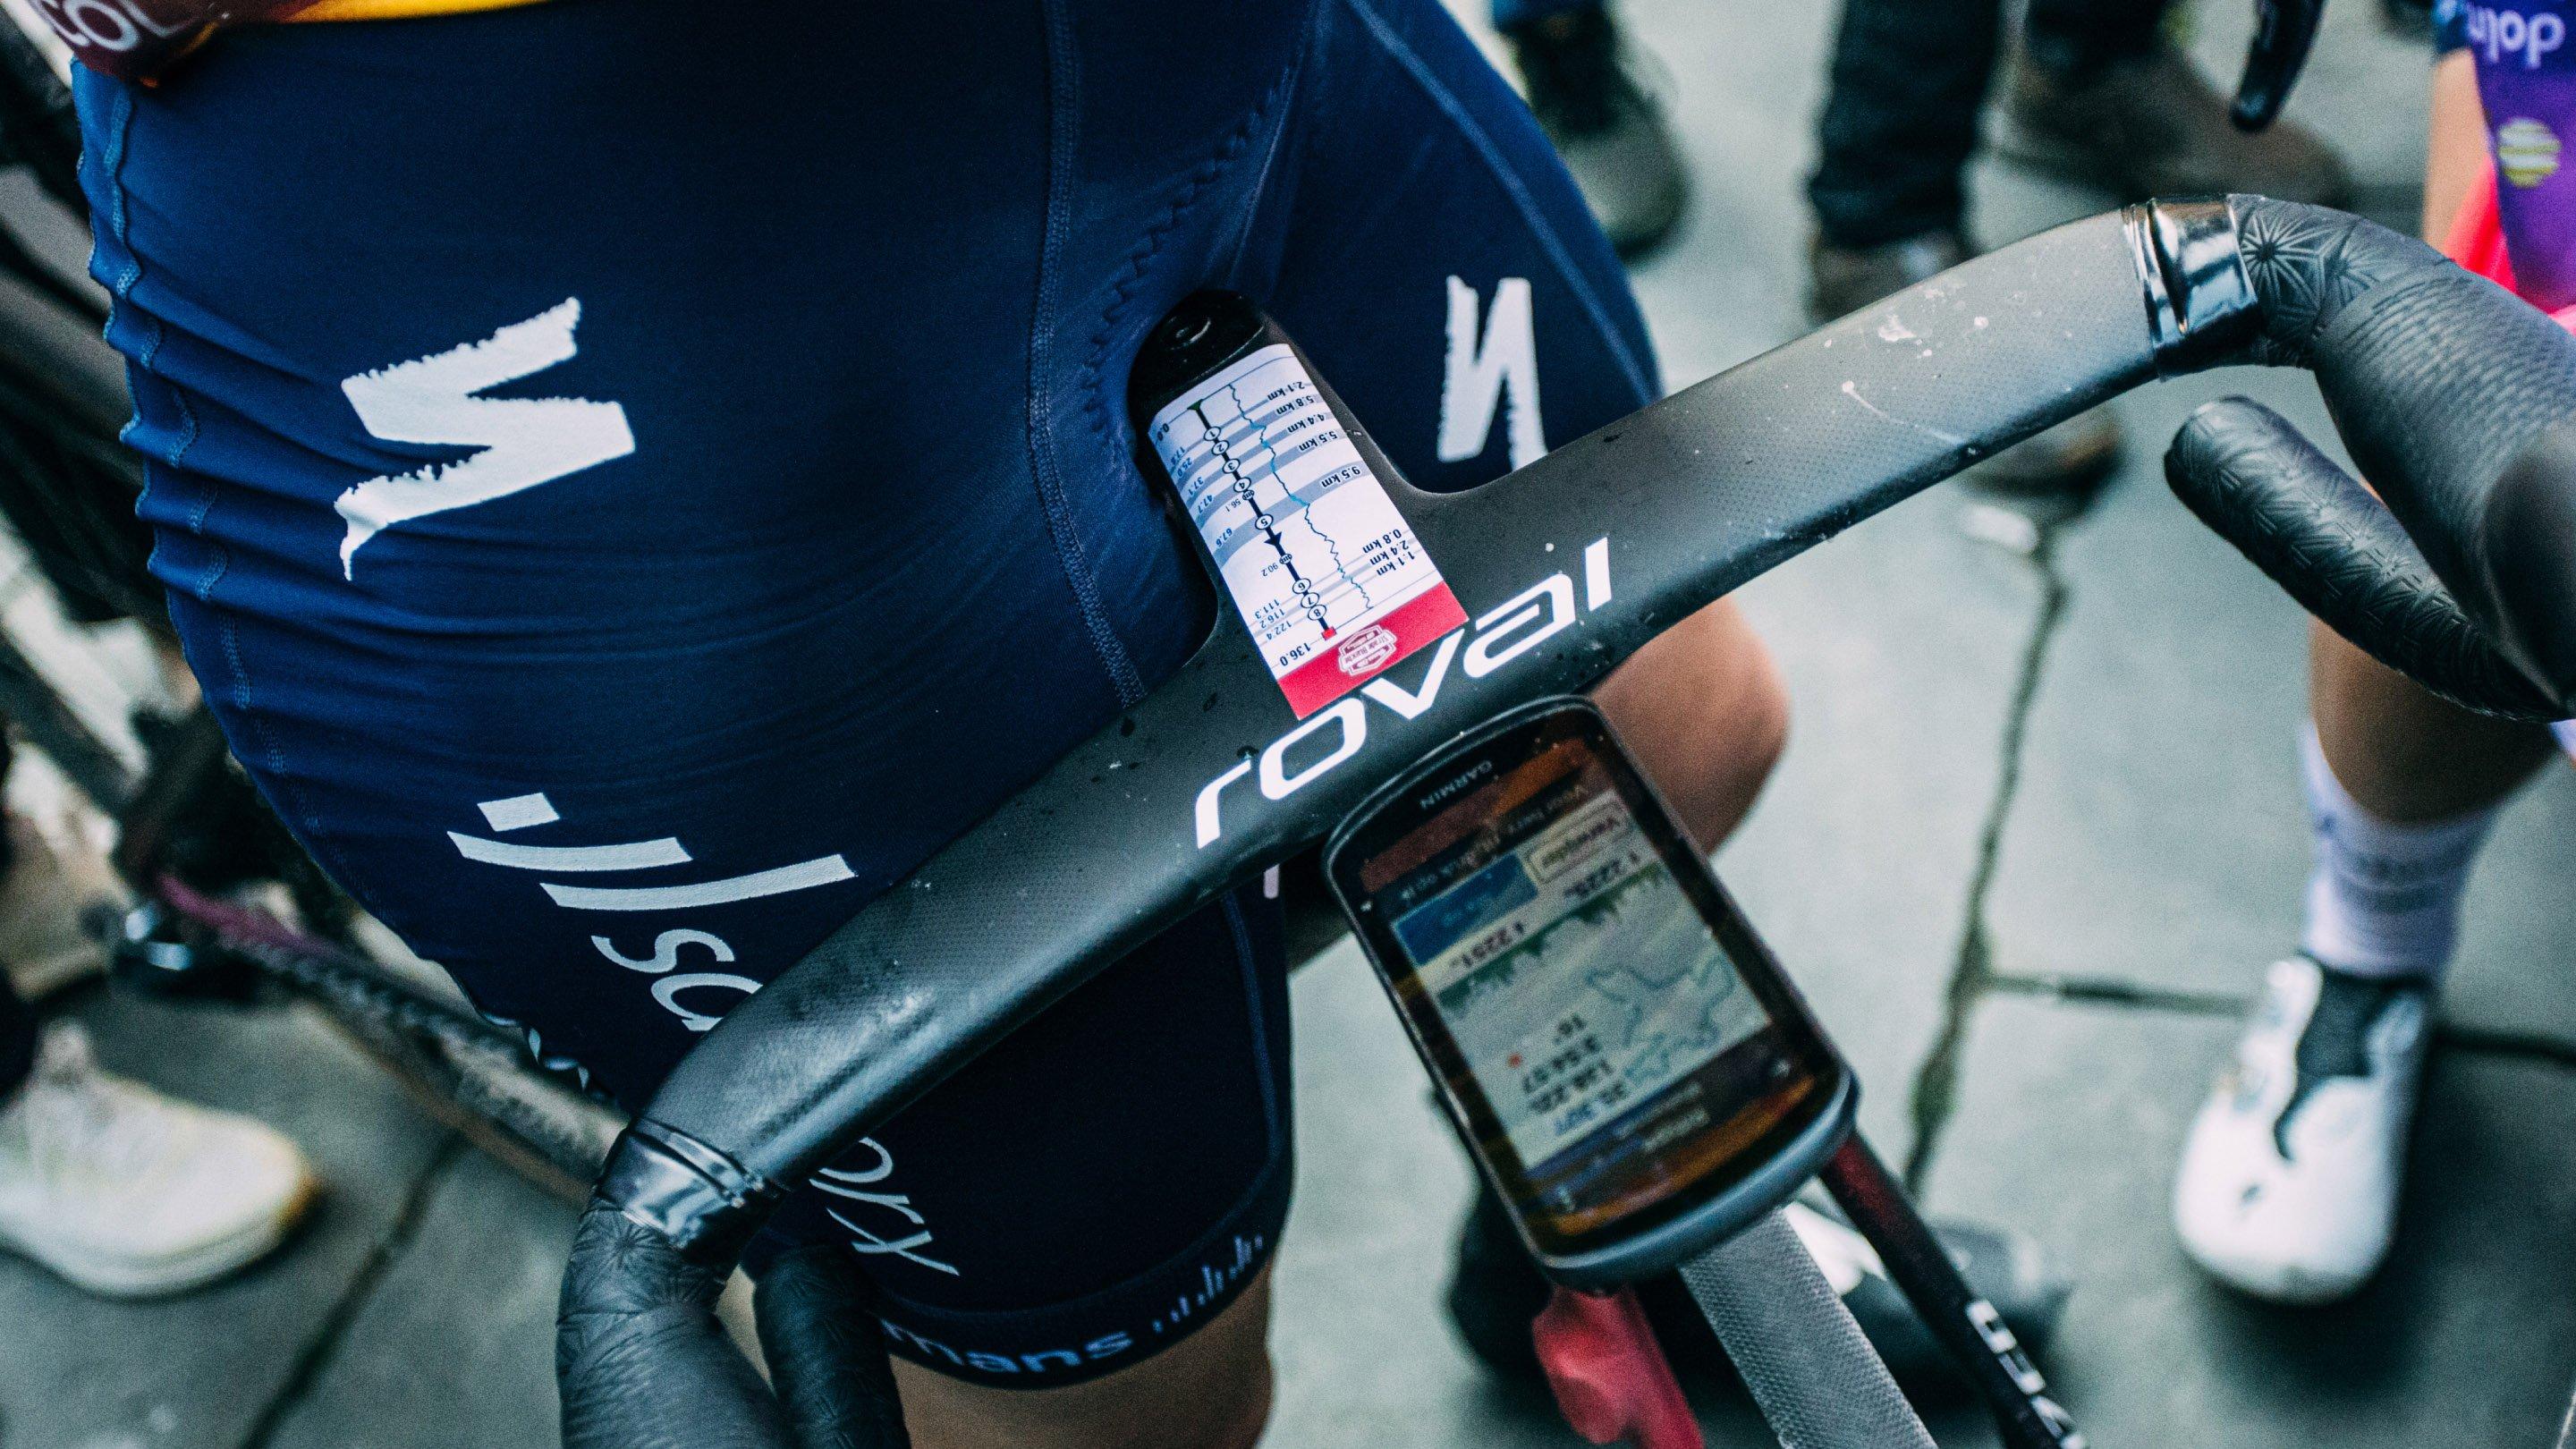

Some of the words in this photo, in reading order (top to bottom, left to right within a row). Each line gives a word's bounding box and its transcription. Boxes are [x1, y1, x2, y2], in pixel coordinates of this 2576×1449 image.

[1287, 381, 1305, 392] 2.1
[1267, 387, 1286, 401] km
[1295, 395, 1315, 407] 5.8
[1275, 402, 1295, 414] km
[1287, 419, 1307, 433] km
[1307, 413, 1326, 425] 4.4
[1318, 431, 1338, 444] 5.5
[1298, 439, 1318, 451] km
[1341, 466, 1361, 479] 9.5
[1321, 474, 1341, 487] km
[1225, 498, 1241, 513] 56.1
[1382, 529, 1402, 545] 0.8
[1362, 539, 1383, 554] km
[1390, 539, 1409, 555] 2.4
[1369, 551, 1390, 565] km
[1397, 551, 1415, 566] 1.1
[1261, 563, 1279, 577] 90.2
[1377, 562, 1396, 576] km
[1254, 598, 1280, 620] 111.3
[1259, 608, 1285, 629] 116.2
[1266, 621, 1292, 640] 122.4
[1279, 642, 1312, 666] 136.0
[1195, 537, 1612, 850] roval
[1419, 760, 1493, 809] GARMIN
